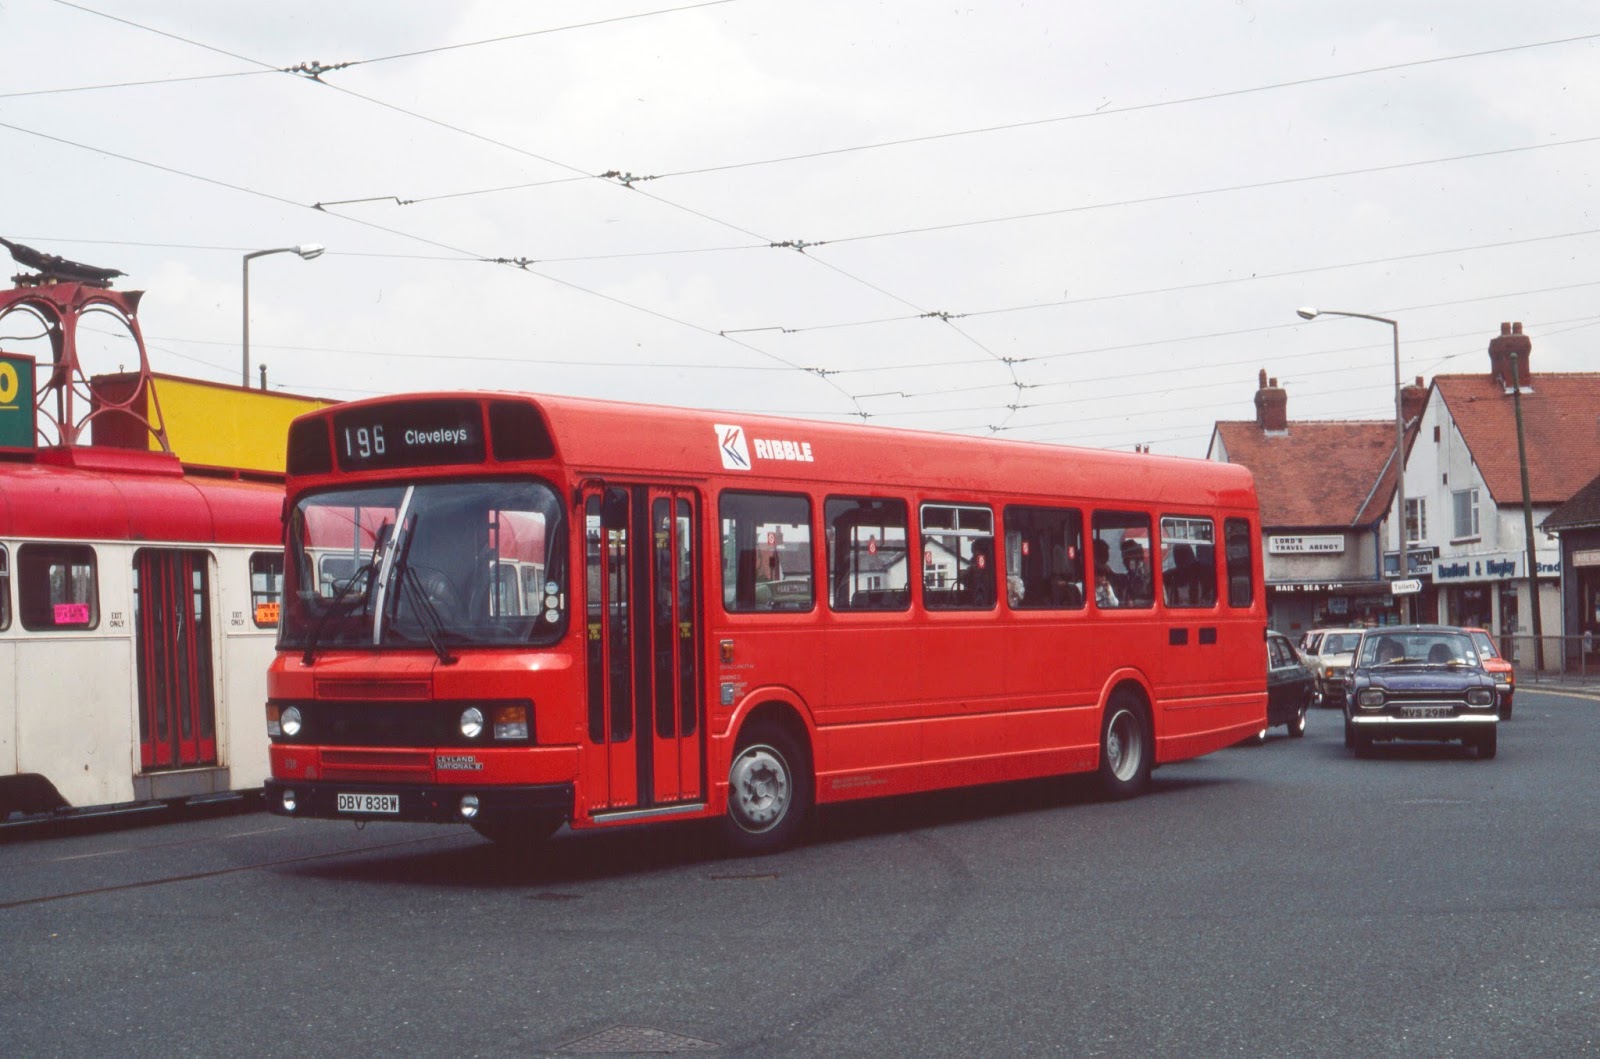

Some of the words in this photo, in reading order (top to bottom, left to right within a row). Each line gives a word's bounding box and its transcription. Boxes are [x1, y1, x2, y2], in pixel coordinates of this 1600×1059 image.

[345, 425, 385, 457] 196
[404, 428, 467, 444] Cleveleys
[753, 438, 814, 462] RIBBLE
[1438, 561, 1470, 578] Bradford
[1475, 560, 1482, 577] &
[1486, 558, 1516, 577] Bingley
[1393, 582, 1416, 590] Toilets
[111, 611, 122, 619] EXIT
[109, 620, 125, 628] ONLY
[1402, 708, 1423, 717] NVS
[339, 795, 362, 810] DBV
[365, 796, 398, 811] 838W
